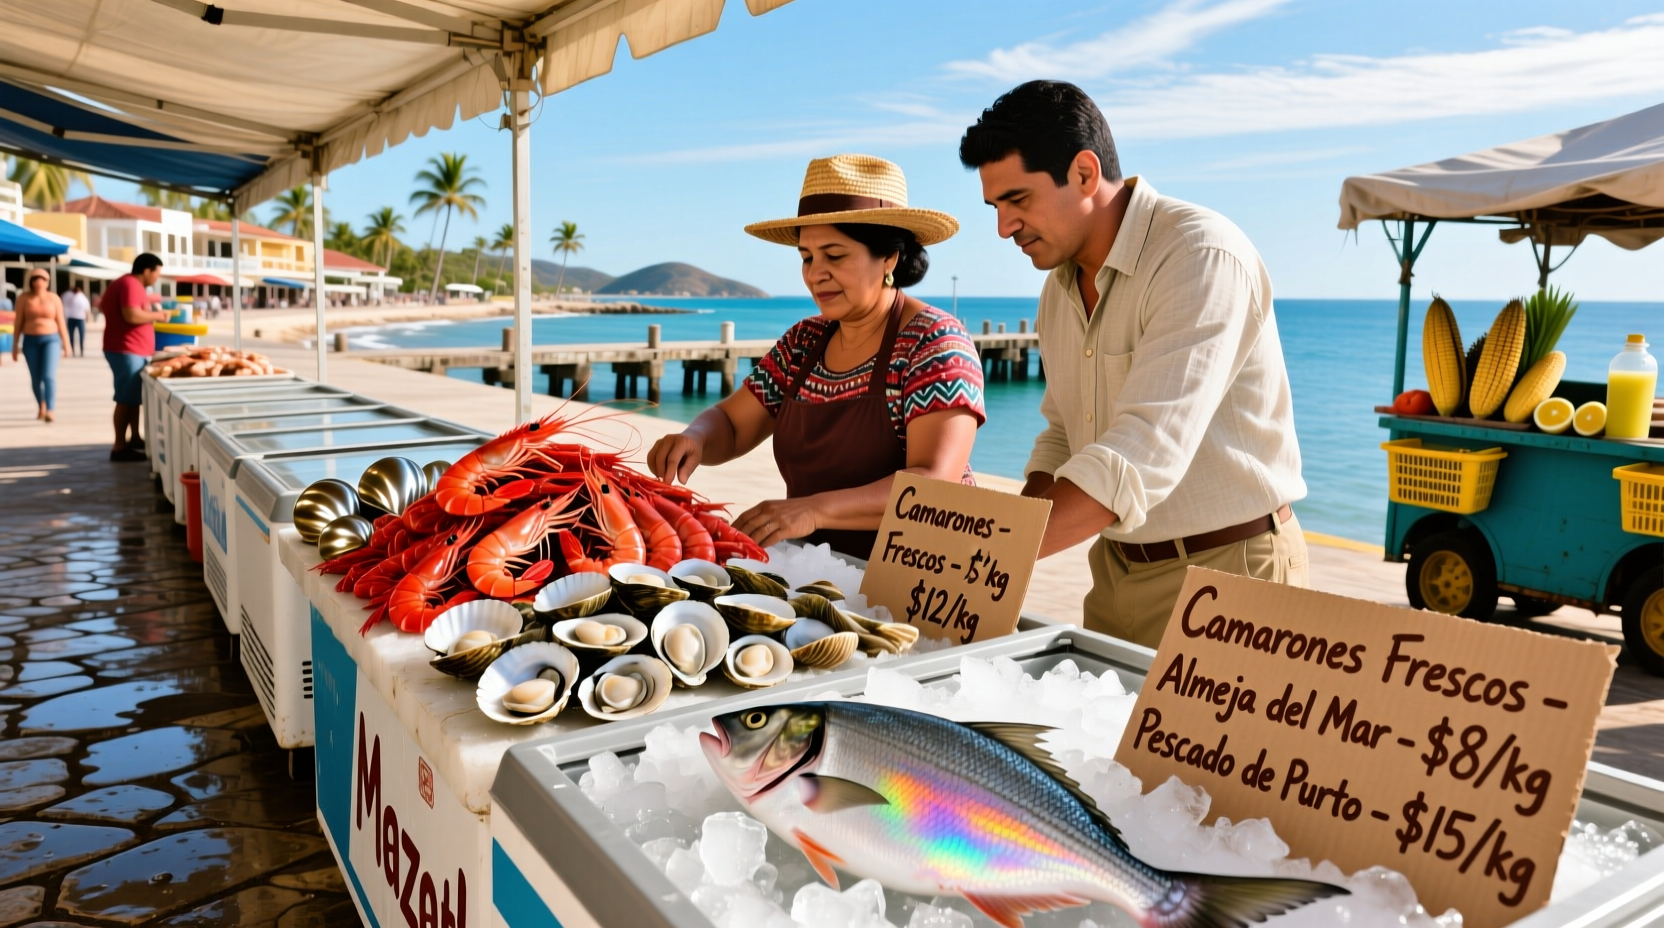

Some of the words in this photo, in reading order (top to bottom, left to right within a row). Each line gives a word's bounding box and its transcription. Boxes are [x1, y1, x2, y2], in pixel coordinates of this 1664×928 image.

[882, 531, 946, 574] Frescos
[896, 486, 995, 538] Camarones
[906, 579, 979, 645] $12/kg
[1181, 586, 1367, 674] Camarones
[1382, 634, 1529, 712] Frescos
[1156, 653, 1256, 723] Almeja
[1266, 683, 1317, 729] del
[1318, 696, 1391, 749] Mar
[1421, 717, 1552, 816] $8/kg
[1133, 708, 1235, 777] Pescado
[1241, 749, 1275, 793] de
[1280, 759, 1362, 821] Purto
[1396, 791, 1536, 907] $15/kg
